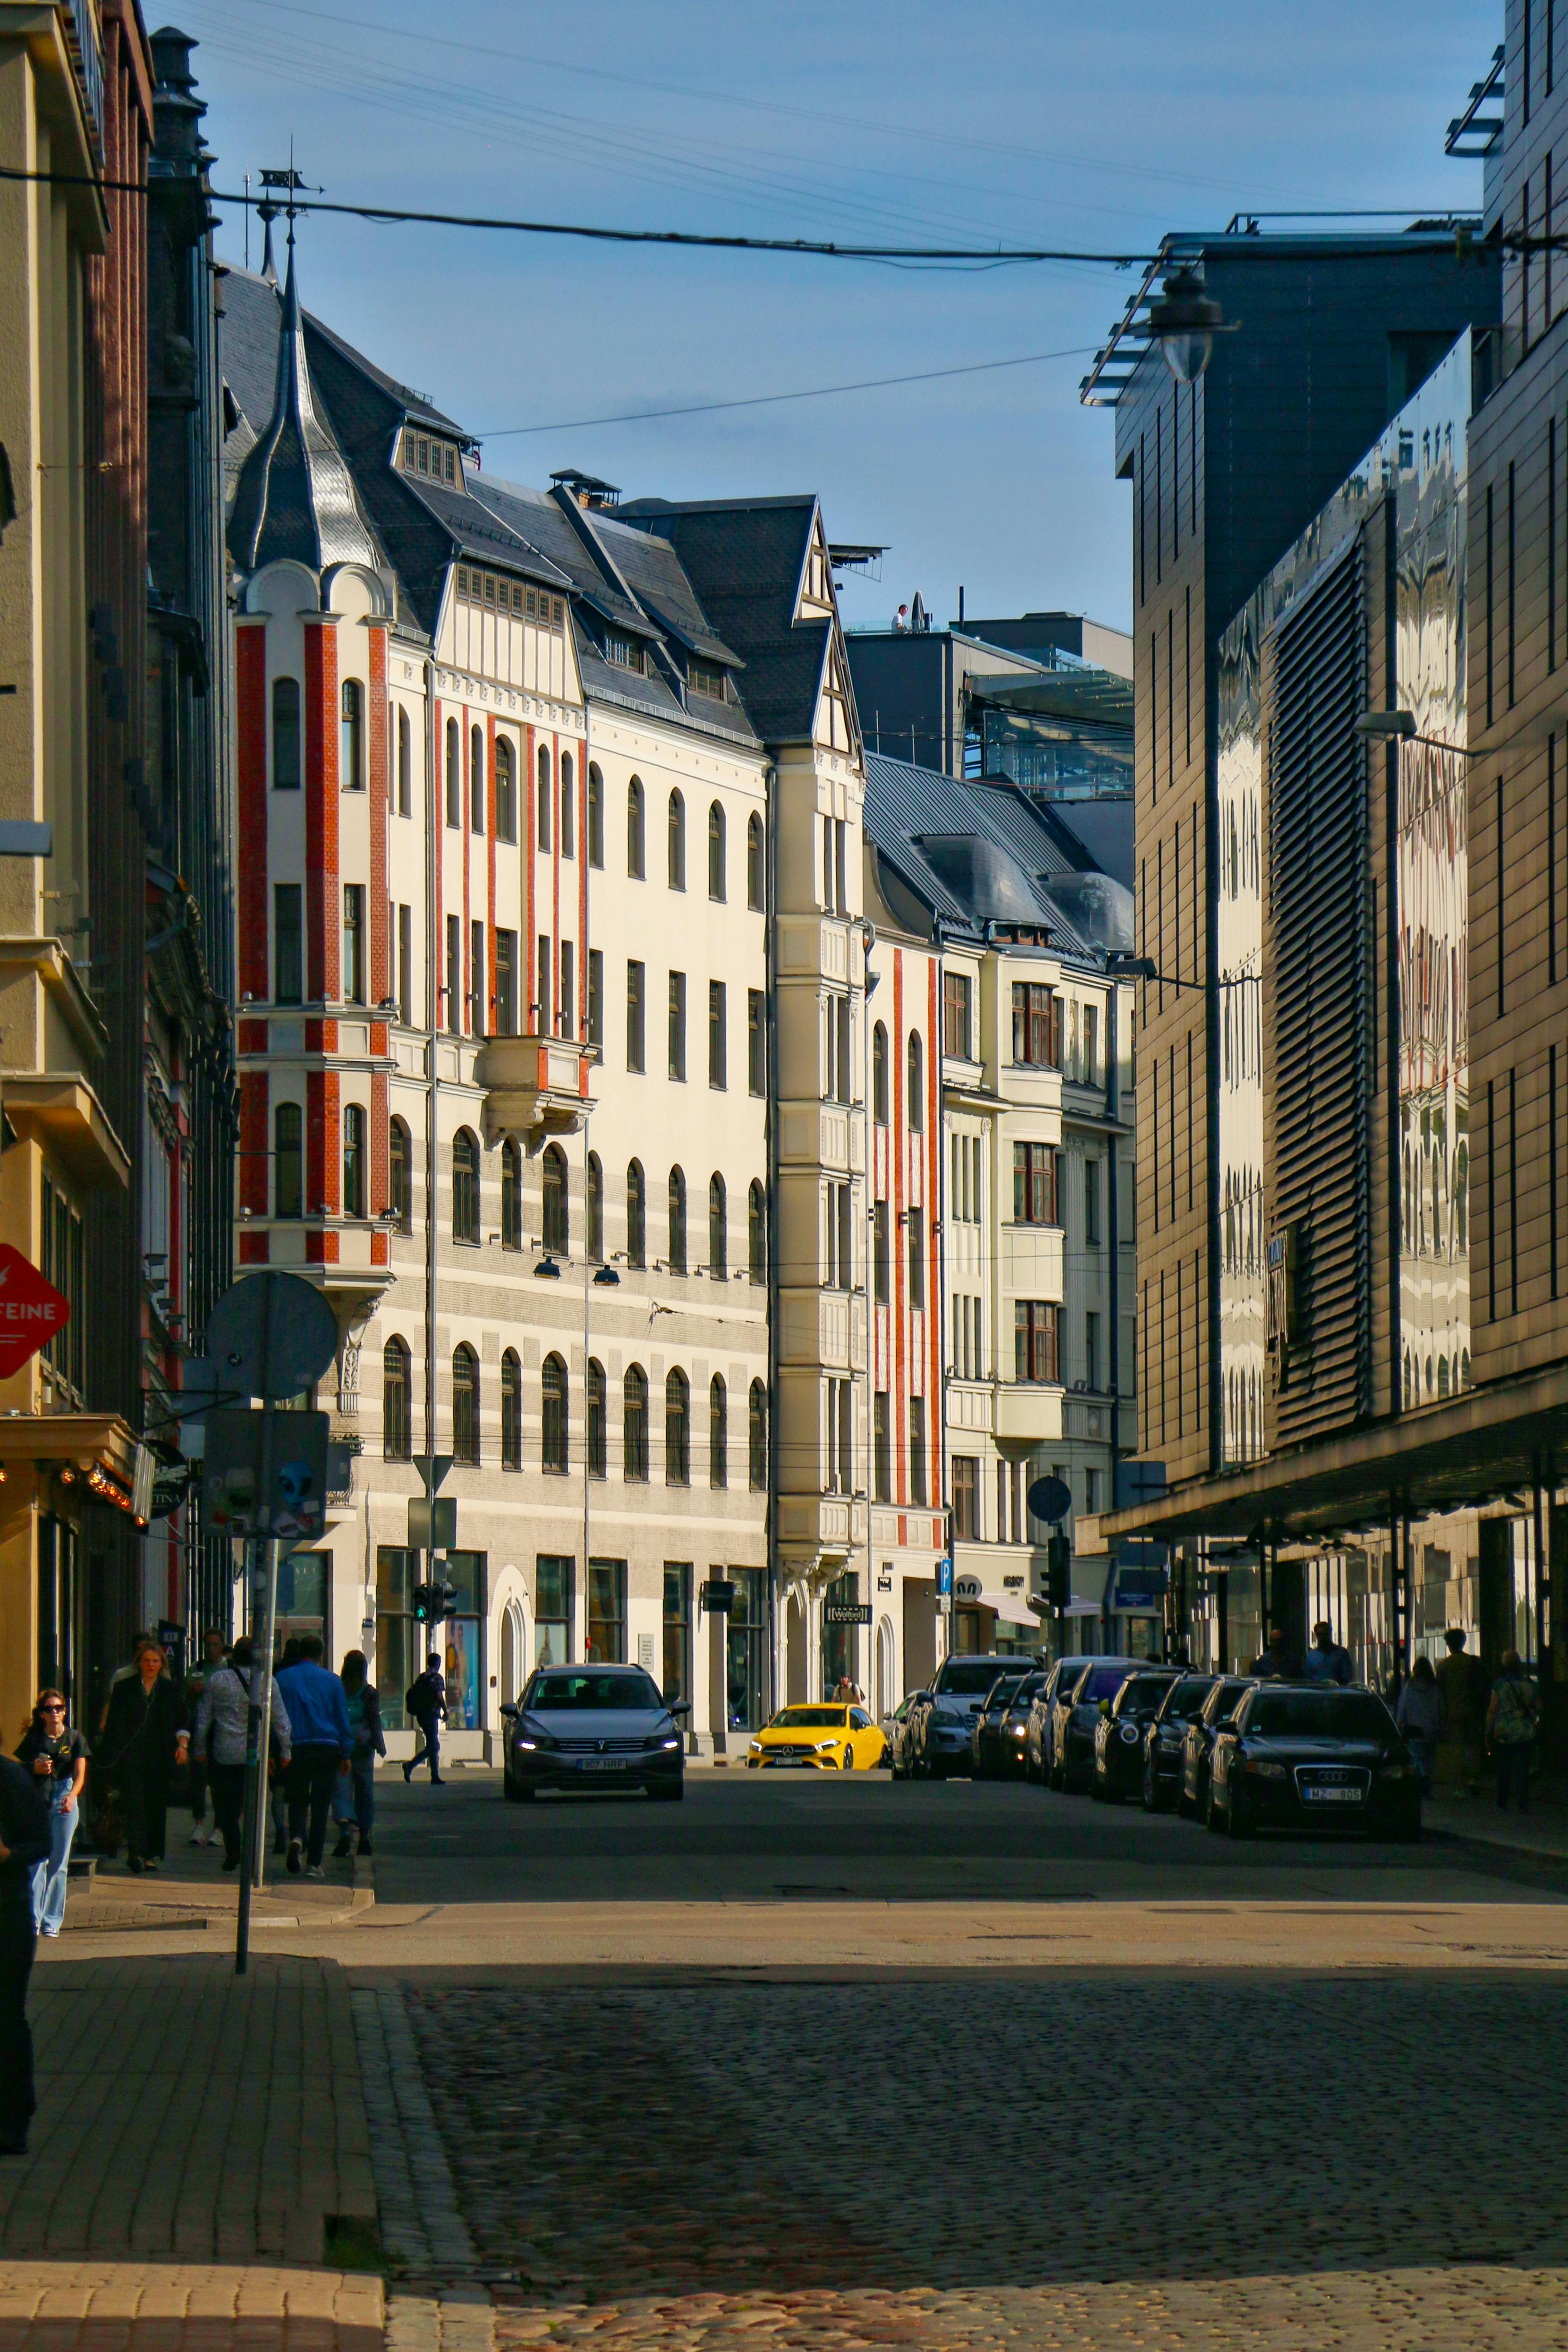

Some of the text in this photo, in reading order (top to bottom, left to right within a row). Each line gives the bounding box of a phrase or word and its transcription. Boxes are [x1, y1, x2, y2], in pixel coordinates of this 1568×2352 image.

[153, 1494, 180, 1504] TINA
[943, 1563, 949, 1588] P
[835, 1610, 861, 1618] Wolford
